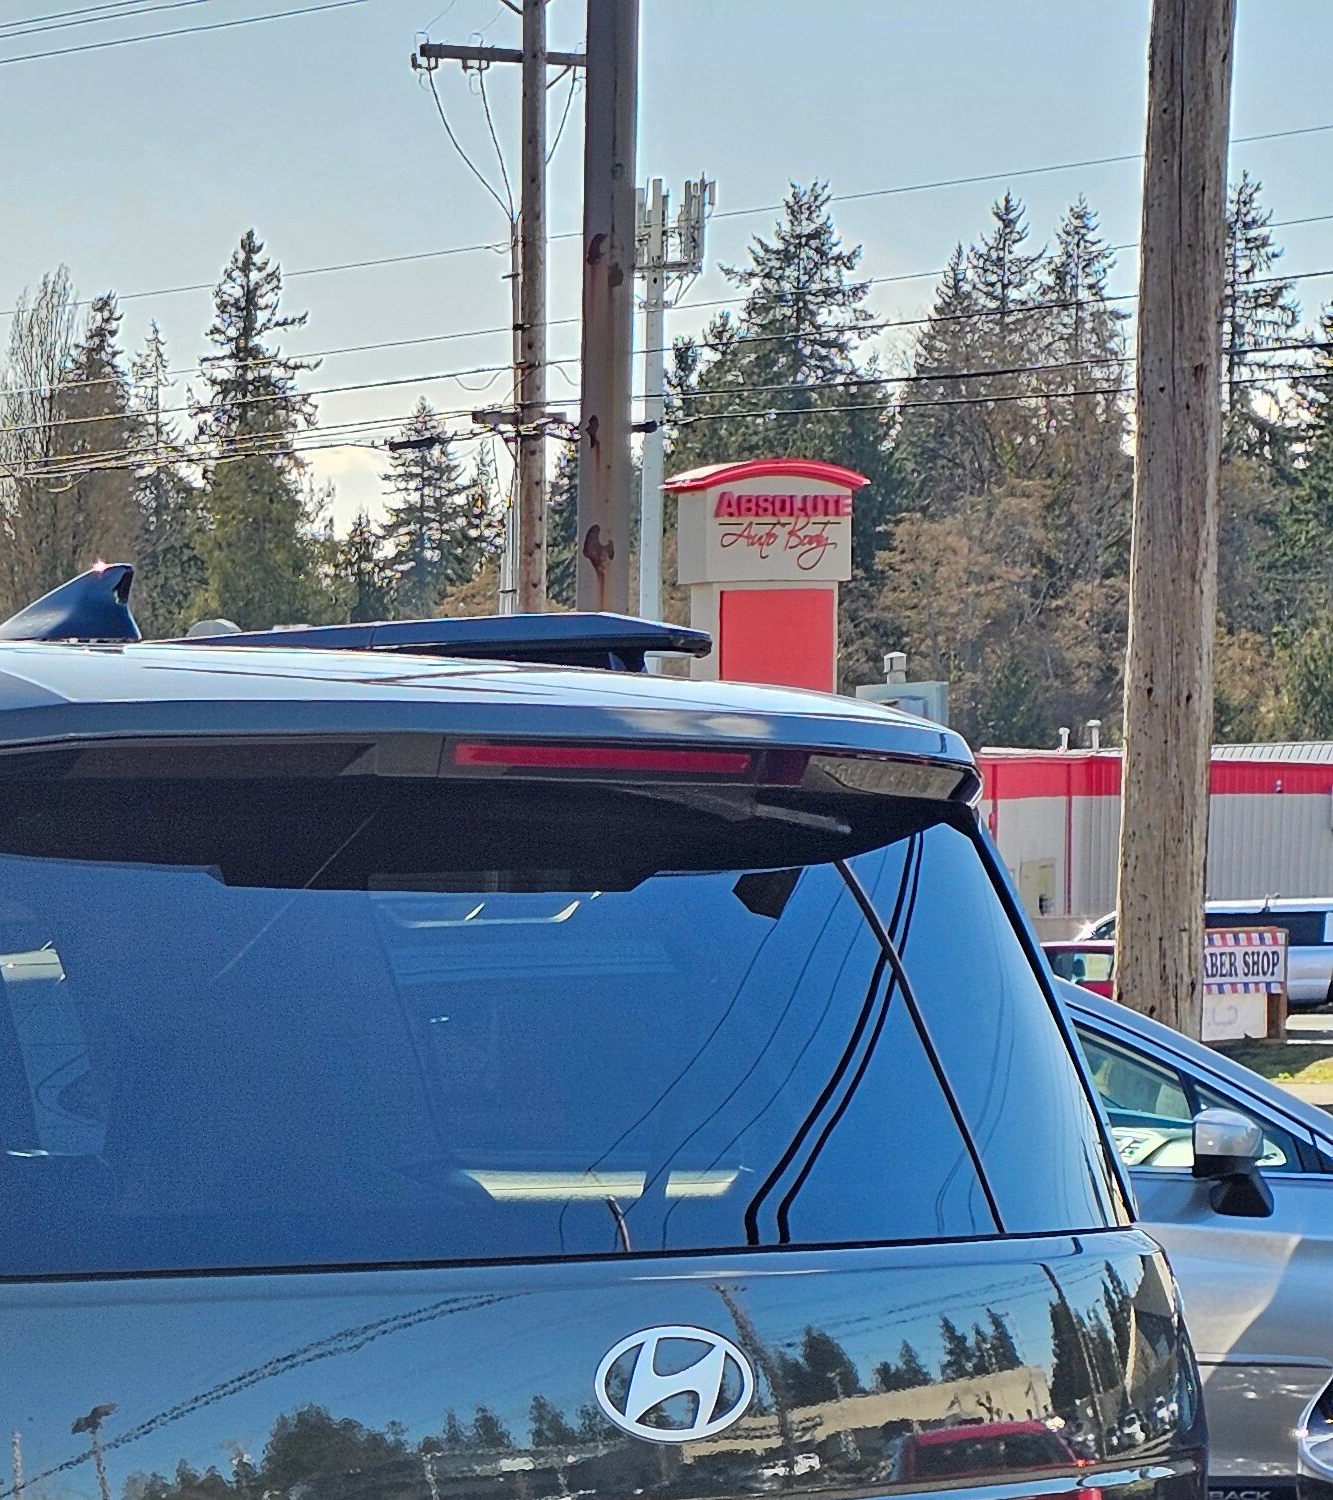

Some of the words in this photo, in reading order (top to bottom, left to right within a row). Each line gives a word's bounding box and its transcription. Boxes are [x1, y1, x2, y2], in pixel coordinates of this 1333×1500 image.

[714, 491, 852, 518] ABSOLUTE
[721, 519, 783, 559] Auto
[783, 516, 838, 570] Body
[1242, 950, 1280, 977] SHOP
